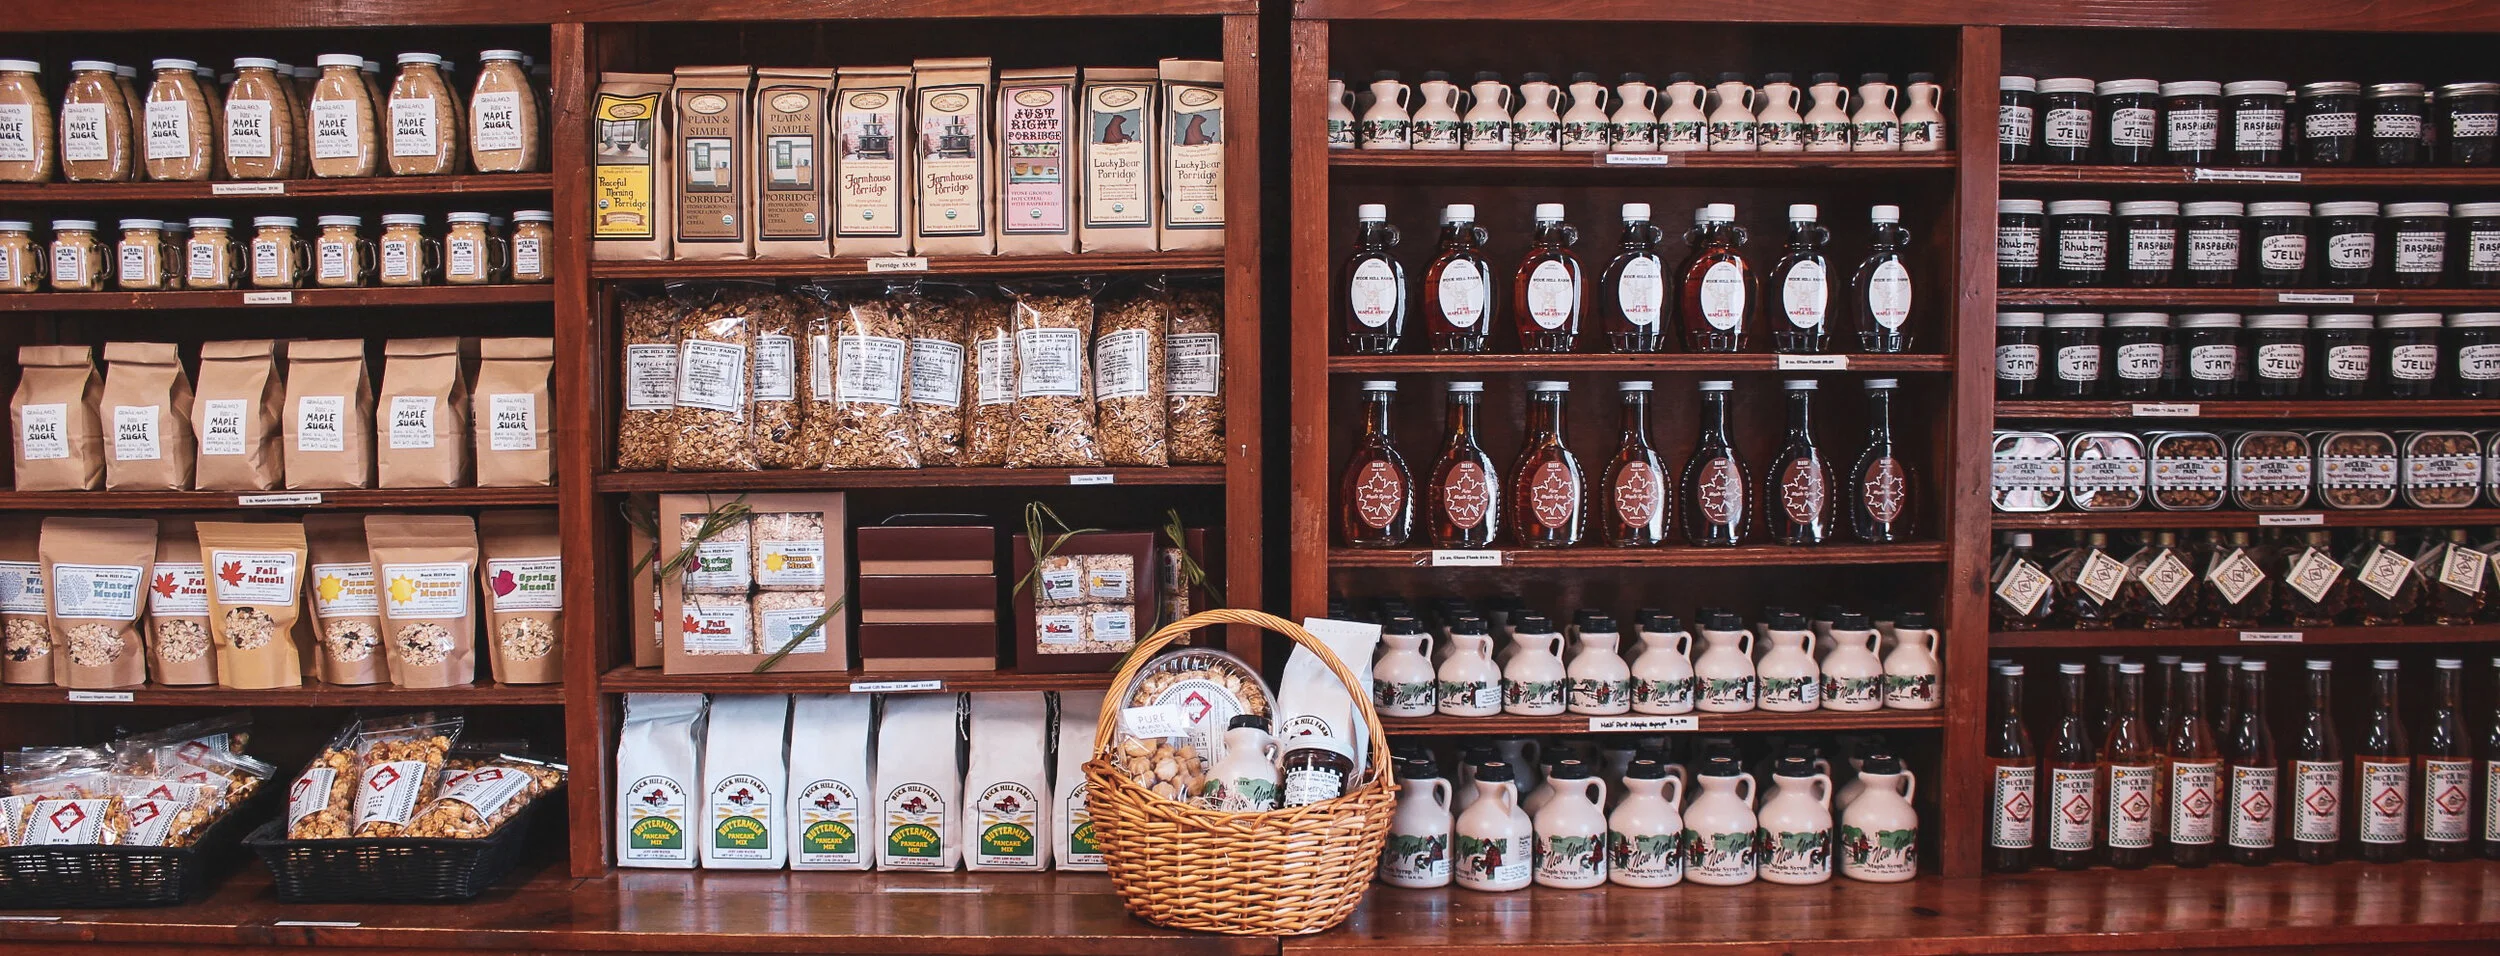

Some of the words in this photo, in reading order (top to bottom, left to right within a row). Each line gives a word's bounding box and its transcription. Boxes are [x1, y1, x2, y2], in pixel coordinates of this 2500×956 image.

[483, 111, 512, 120] MAPLE
[770, 114, 801, 122] PLAIN
[1015, 109, 1055, 118] JUST
[231, 119, 261, 129] MAPLE
[319, 119, 347, 128] MAPLE
[397, 119, 426, 127] MAPLE
[483, 120, 513, 129] SUGAR
[688, 116, 719, 124] PLAIN
[1011, 120, 1058, 129] RIGHT
[0, 122, 23, 132] APLE
[69, 122, 97, 131] MAPLE
[151, 120, 178, 130] MAPLE
[772, 125, 809, 133] SIMPLE
[70, 131, 98, 140] SUGAR
[152, 130, 180, 138] SUGAR
[232, 129, 261, 138] SUGAR
[319, 127, 347, 137] SUGAR
[398, 127, 426, 137] SUGAR
[690, 127, 728, 135] SIMPLE
[2000, 125, 2029, 138] JELLY
[2057, 128, 2089, 139] JELLY
[2124, 128, 2153, 139] JELLY
[0, 132, 24, 141] UGAR
[1094, 159, 1119, 169] Lucky
[1119, 159, 1140, 167] Bear
[1175, 160, 1199, 170] Lucky
[1200, 160, 1221, 169] Bear
[1097, 169, 1136, 182] Porridge
[1178, 171, 1217, 183] Porridge
[599, 177, 626, 188] Peaceful
[846, 173, 891, 190] Farmhouse
[927, 172, 973, 189] Farmhouse
[606, 188, 633, 198] Morning
[852, 183, 887, 196] Porridge
[935, 183, 970, 195] Porridge
[684, 195, 735, 203] PORRIDGE
[766, 193, 816, 201] PORRIDGE
[614, 198, 647, 210] Porridge
[2271, 250, 2305, 260] JELLY
[2343, 249, 2370, 258] JAM
[2007, 360, 2034, 369] JAM
[2072, 361, 2097, 369] JAM
[2131, 359, 2159, 368] JAM
[2204, 360, 2232, 369] JAM
[2267, 359, 2301, 368] JELLY
[2401, 360, 2434, 369] JELLY
[306, 413, 336, 422] MAPLE
[397, 410, 427, 419] MAPLE
[497, 412, 527, 421] MAPLE
[211, 417, 239, 426] MAPLE
[396, 418, 427, 428] SUGAR
[497, 421, 528, 430] SUGAR
[28, 423, 56, 432] MAPLE
[119, 423, 149, 432] MAPLE
[209, 426, 239, 435] SUGAR
[305, 422, 335, 431] SUGAR
[28, 432, 57, 441] SUGAR
[120, 432, 149, 441] SUGAR
[255, 566, 278, 575] Fall
[248, 575, 284, 584] Muesli
[519, 573, 557, 583] Spring
[93, 581, 133, 590] Winter
[415, 580, 462, 588] Summer
[519, 582, 555, 591] Muesli
[94, 589, 131, 599] Muesli
[420, 588, 456, 597] Muesli
[707, 620, 725, 628] Fall
[1138, 713, 1165, 723] PURE
[1315, 721, 1329, 736] FARM
[633, 781, 647, 795] BUCK
[664, 780, 679, 795] FARM
[718, 779, 733, 793] BUCK
[750, 779, 765, 794] FARM
[805, 784, 819, 798] BUCK
[835, 784, 851, 799] FARM
[891, 787, 906, 801] BUCK
[922, 787, 939, 803] FARM
[984, 786, 999, 801] BUCK
[1015, 786, 1032, 801] FARM
[633, 819, 678, 836] BUTTERMILK
[719, 819, 764, 836] BUTTERMILK
[806, 824, 851, 841] BUTTERMILK
[892, 827, 937, 843] BUTTERMILK
[984, 827, 1029, 843] BUTTERMILK
